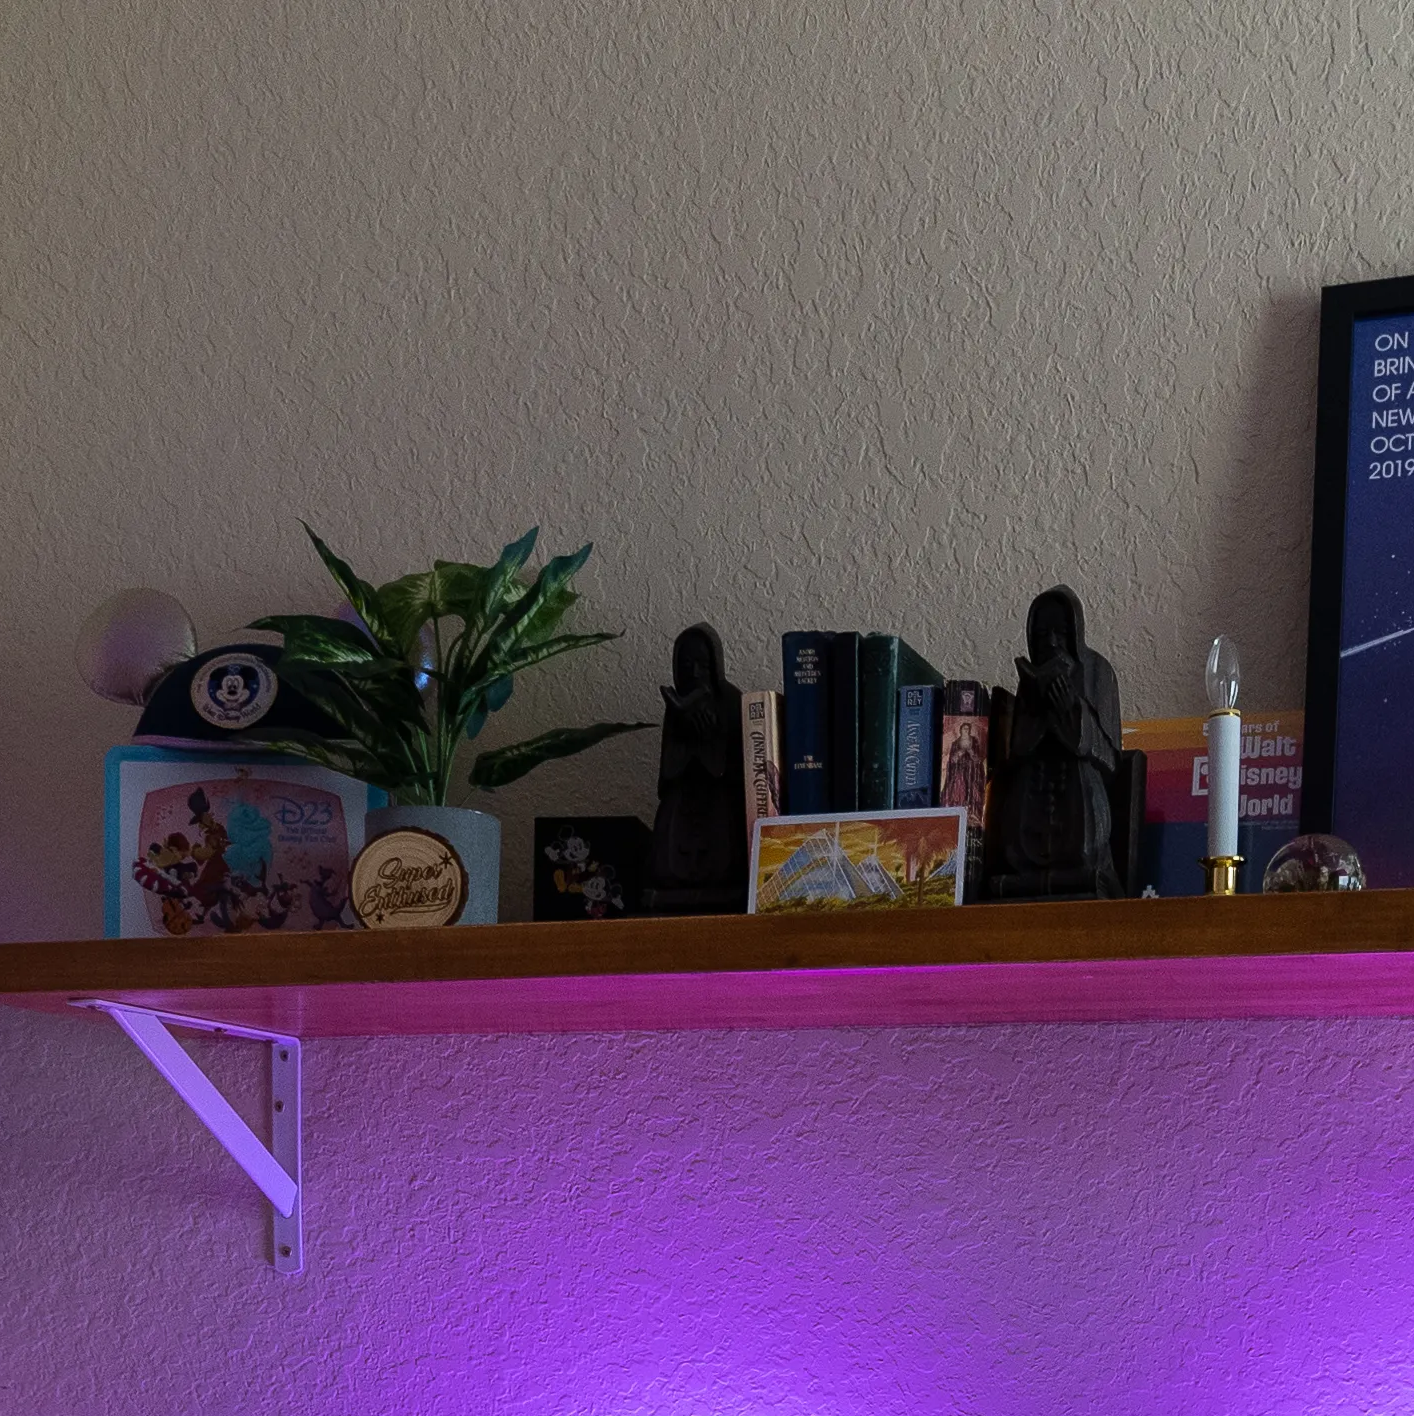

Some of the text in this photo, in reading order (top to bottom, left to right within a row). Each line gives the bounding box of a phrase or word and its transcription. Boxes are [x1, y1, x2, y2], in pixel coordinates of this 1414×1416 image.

[1374, 331, 1409, 351] ON
[1372, 383, 1402, 403] OF
[1265, 720, 1280, 732] of
[1240, 735, 1298, 760] Walt
[1240, 764, 1303, 789] isney
[273, 796, 332, 825] D23
[378, 857, 443, 890] Super
